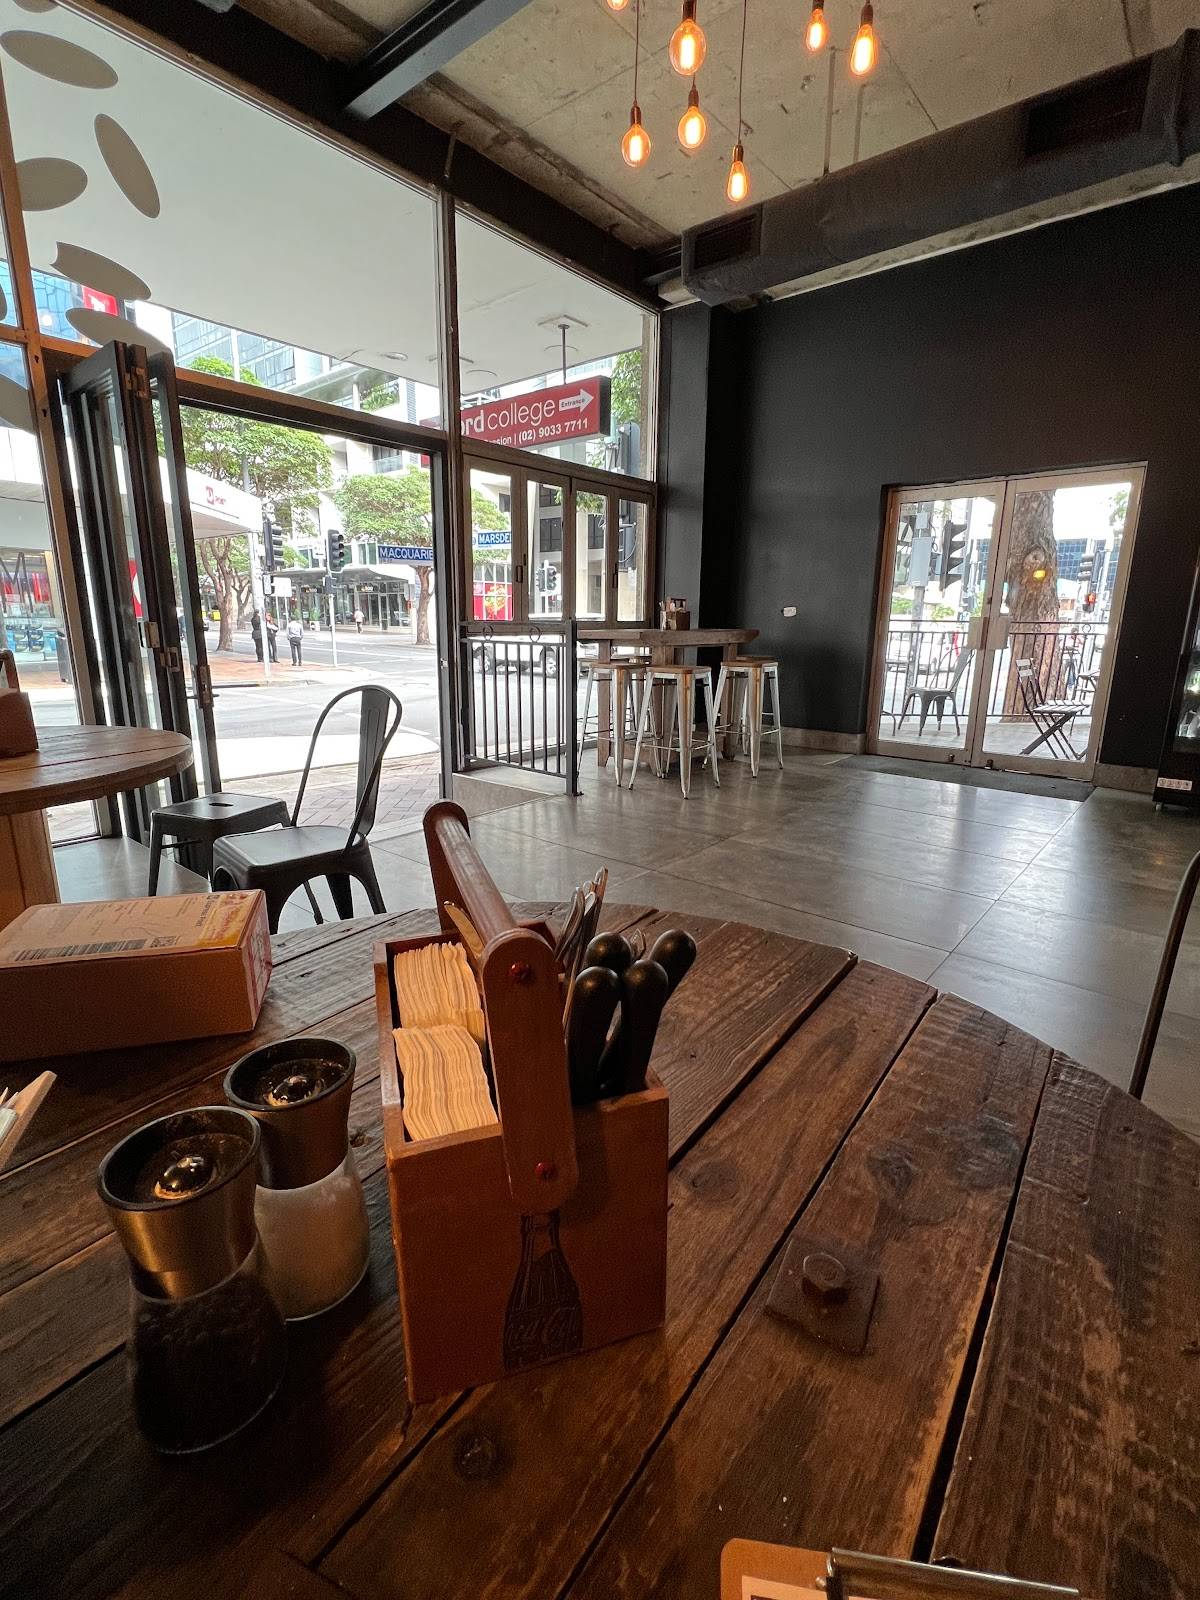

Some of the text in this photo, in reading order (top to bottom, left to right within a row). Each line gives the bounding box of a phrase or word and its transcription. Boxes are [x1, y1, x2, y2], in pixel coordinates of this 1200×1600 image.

[487, 400, 555, 430] college
[561, 398, 586, 408] Entrance
[518, 428, 536, 444] (02)
[539, 423, 562, 438] 9033
[564, 417, 588, 433] 7711
